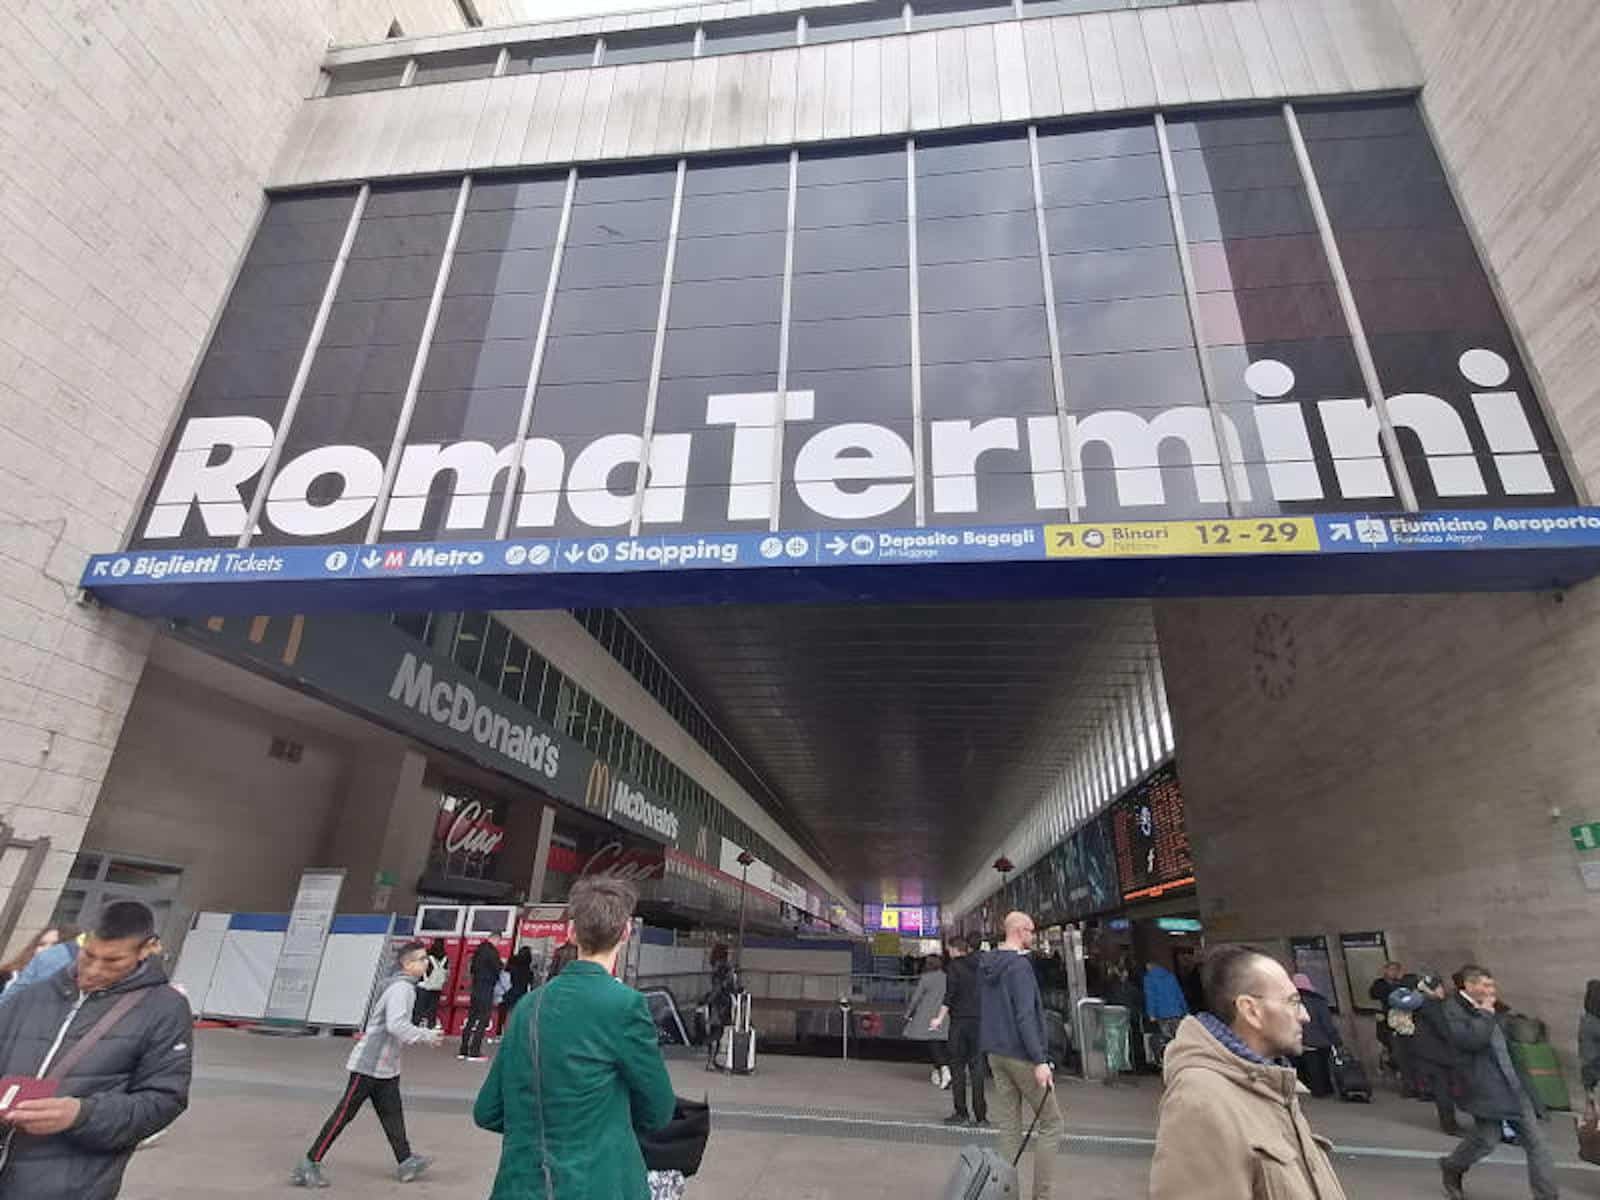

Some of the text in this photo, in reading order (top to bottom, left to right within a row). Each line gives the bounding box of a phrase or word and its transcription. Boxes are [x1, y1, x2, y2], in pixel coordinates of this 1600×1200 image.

[1112, 526, 1169, 541] Binari
[1195, 524, 1231, 544] 12
[1260, 522, 1299, 543] 29
[1390, 515, 1600, 533] Fiumicino Aeroporto
[879, 528, 1035, 551] Deposito Bagagli
[409, 547, 484, 567] Metro
[614, 539, 738, 564] Shopping
[132, 552, 283, 579] Biglietti Tickets
[388, 652, 561, 778] McDonald's
